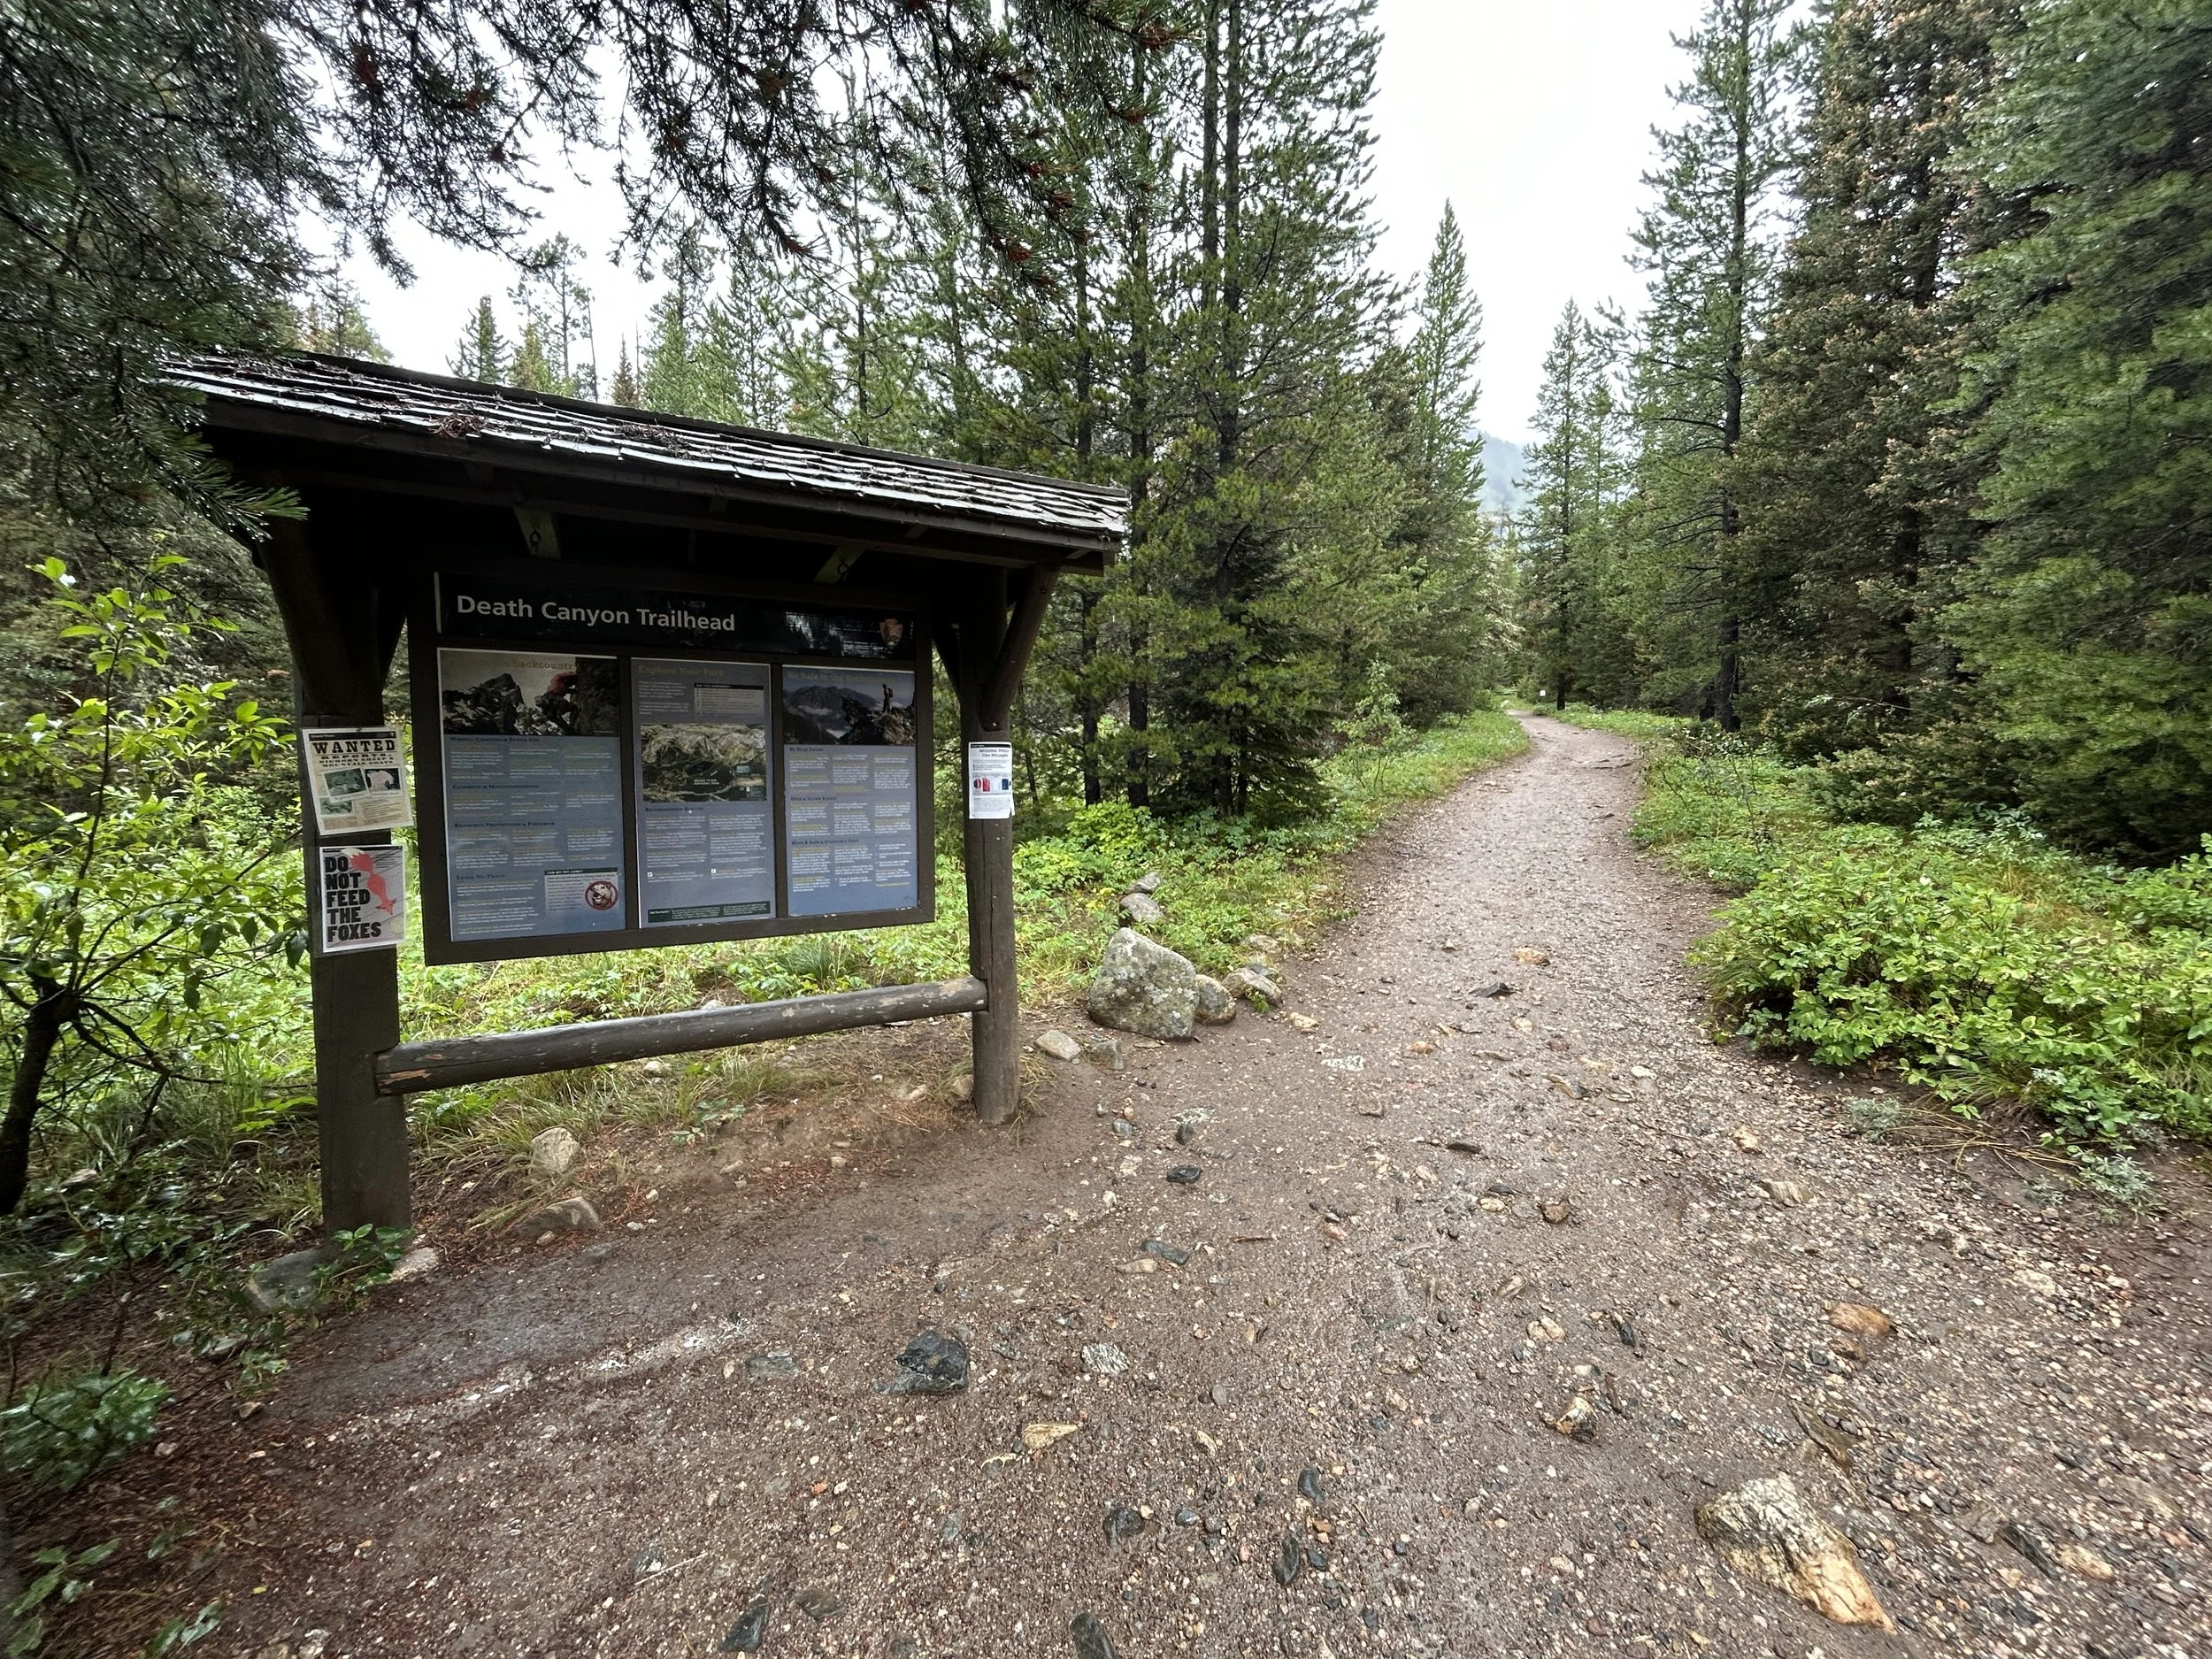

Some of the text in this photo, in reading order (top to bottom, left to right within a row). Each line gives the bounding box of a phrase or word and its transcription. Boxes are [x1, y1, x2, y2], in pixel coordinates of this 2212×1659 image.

[457, 595, 735, 631] Death Canyon Trailhead
[312, 740, 395, 754] WANTED
[324, 856, 349, 873] DO
[325, 872, 361, 890] NOT
[326, 888, 371, 908] FEED
[326, 906, 362, 925] THE
[326, 921, 381, 942] FOXES
